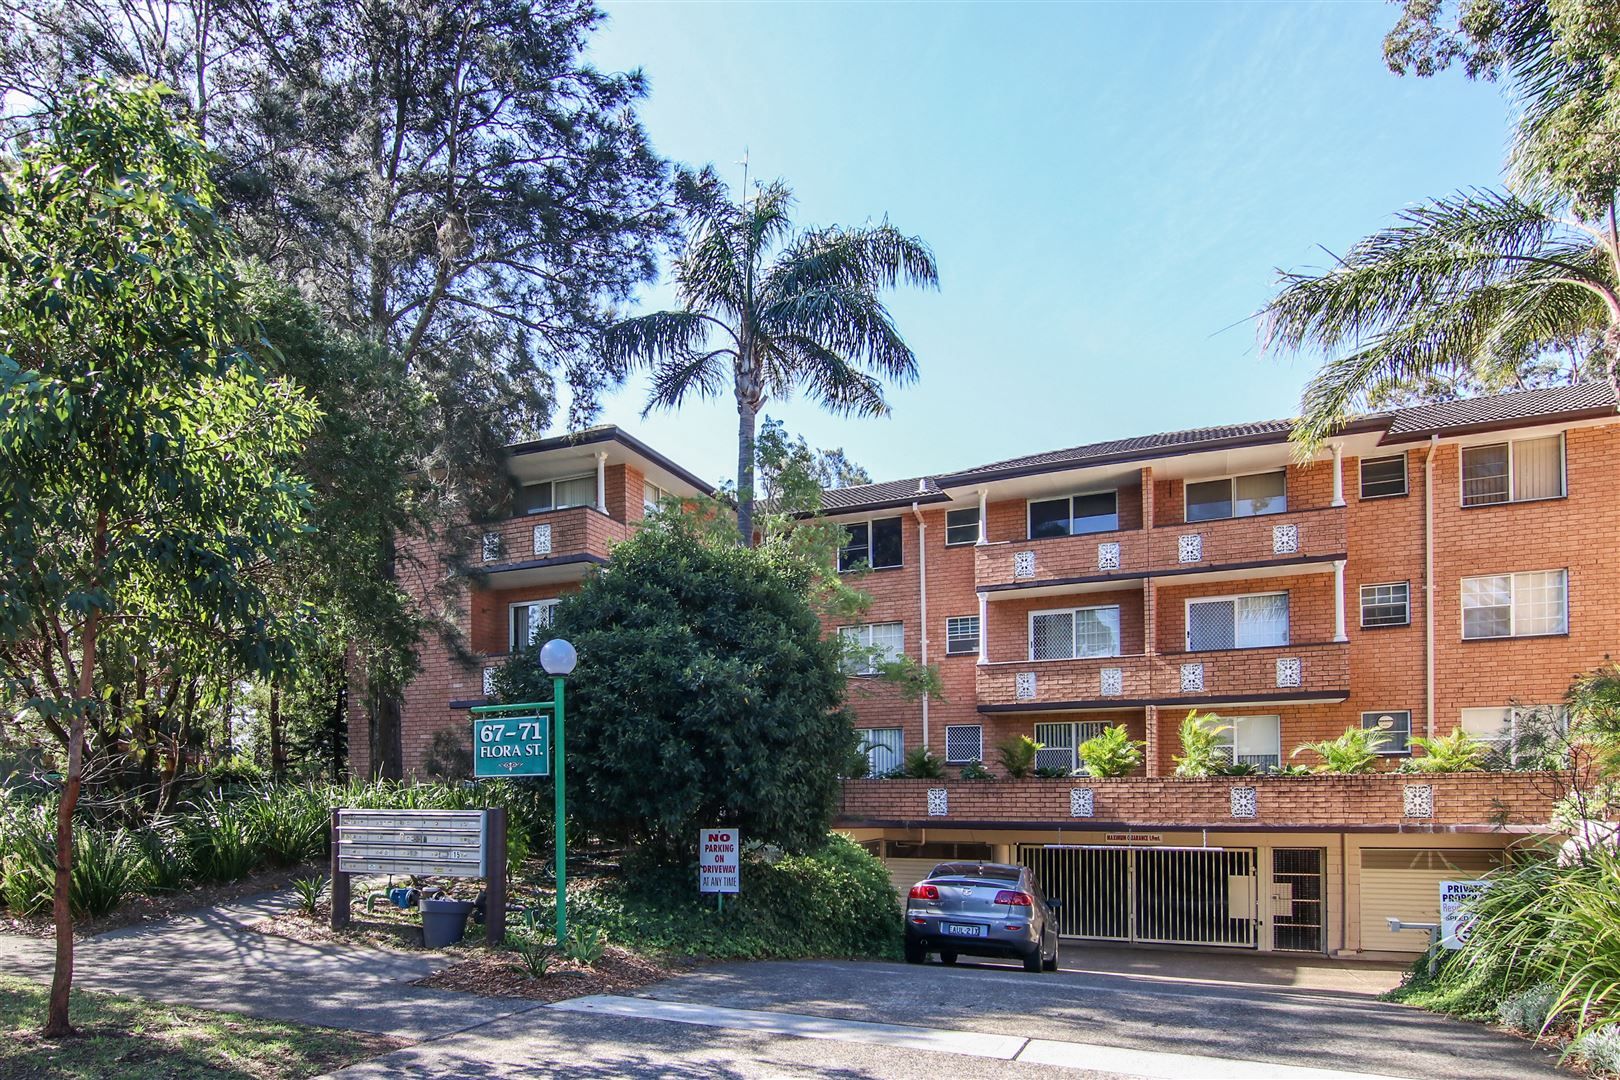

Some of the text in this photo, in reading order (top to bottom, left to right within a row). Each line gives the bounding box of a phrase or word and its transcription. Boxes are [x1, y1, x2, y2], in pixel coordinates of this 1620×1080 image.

[480, 722, 542, 742] 67-71
[480, 743, 543, 758] FLORA ST.
[708, 833, 731, 842] NO
[704, 844, 734, 853] PARKING
[714, 854, 725, 863] ON
[702, 864, 736, 873] DRIVEWAY
[702, 877, 737, 887] AT ANY TIME
